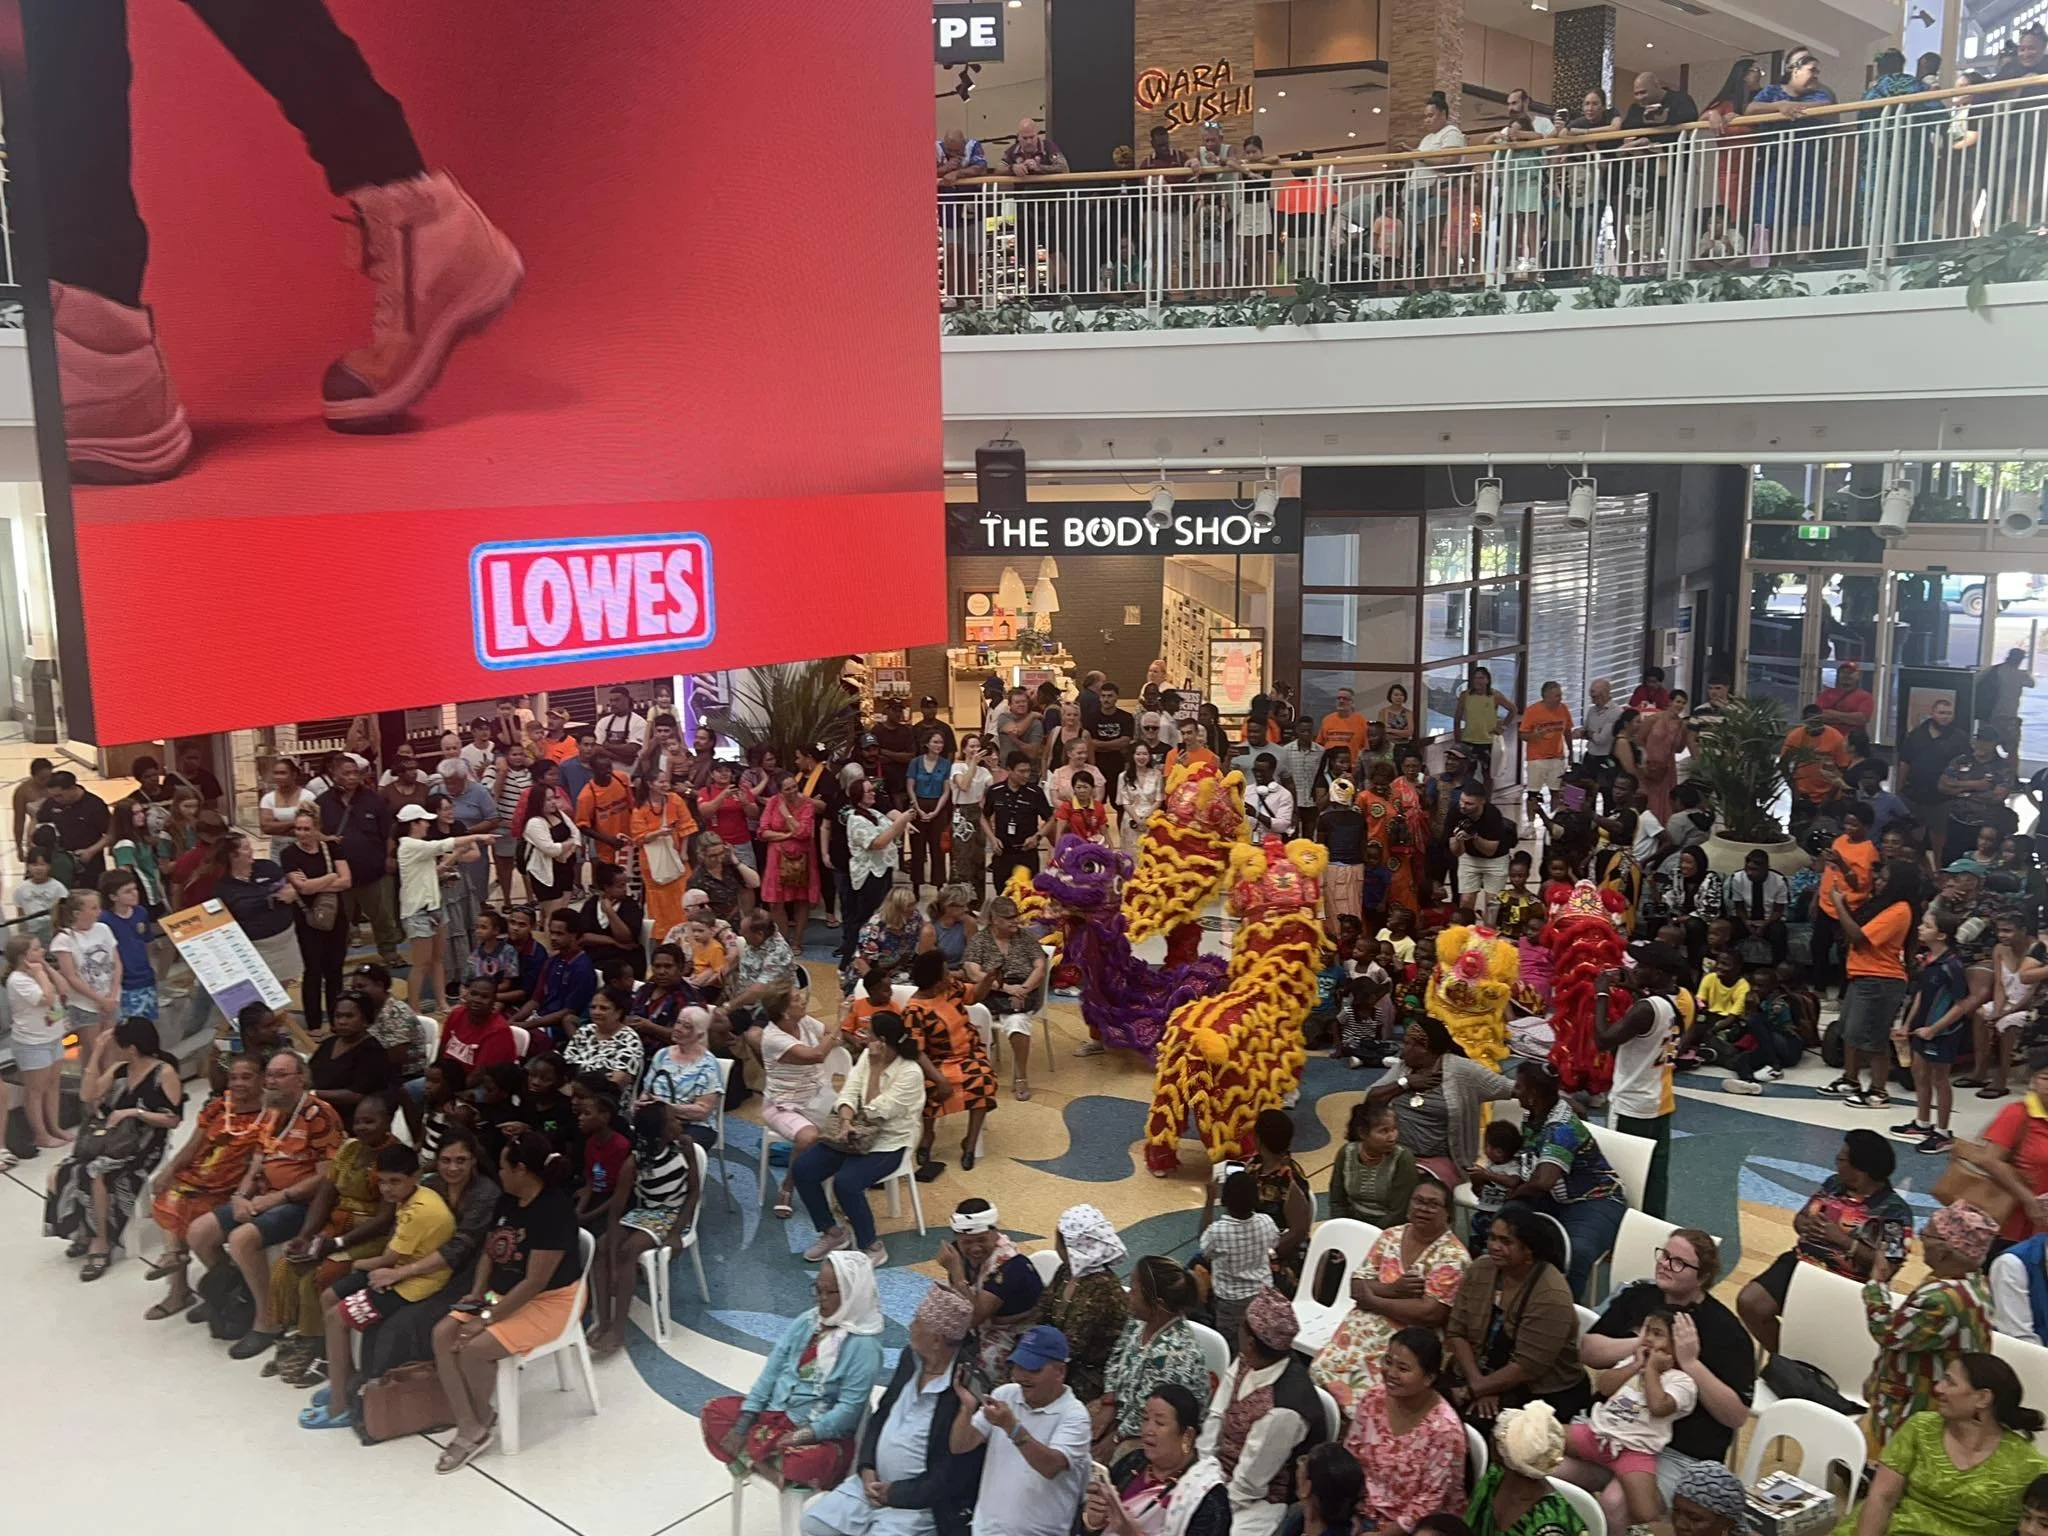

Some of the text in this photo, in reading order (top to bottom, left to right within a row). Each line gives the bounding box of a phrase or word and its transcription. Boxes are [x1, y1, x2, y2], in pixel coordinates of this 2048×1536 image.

[932, 17, 996, 47] PE
[1137, 57, 1233, 109] WARA
[1164, 84, 1252, 132] SUSHI
[980, 511, 1272, 547] THE BODY SHOP
[489, 548, 699, 650] LOWES
